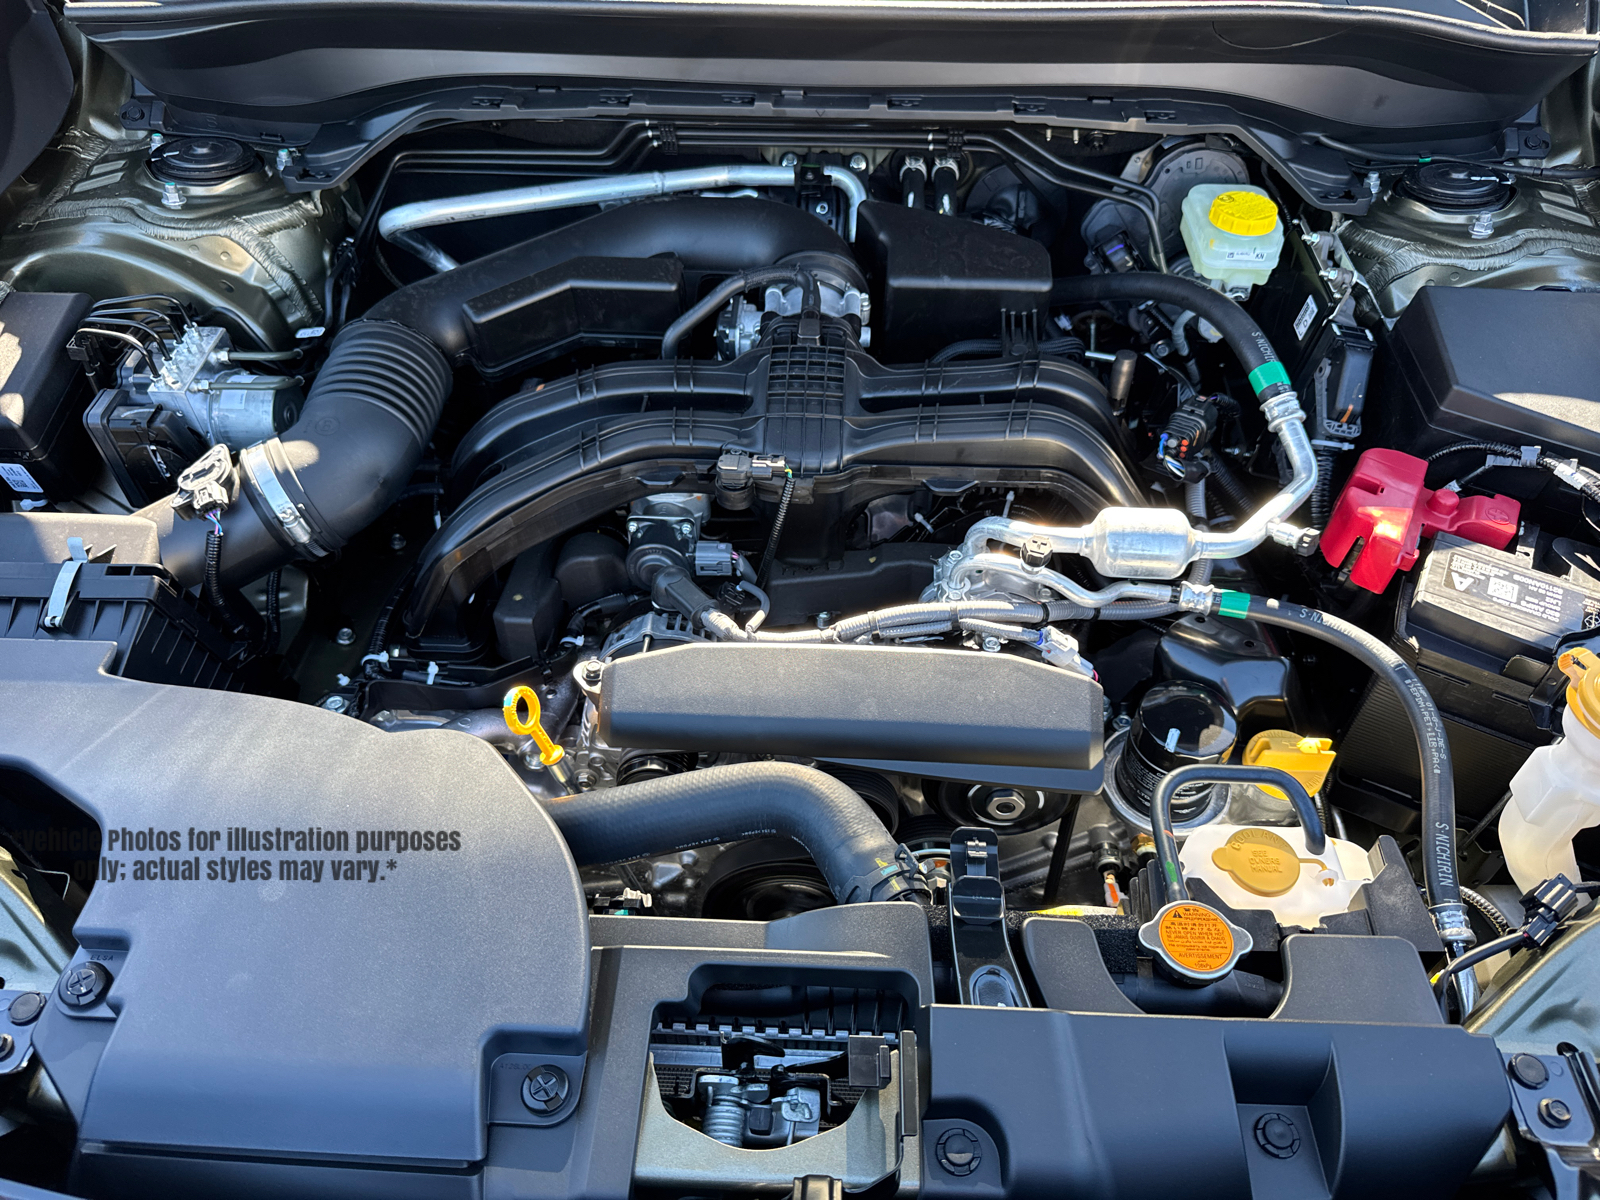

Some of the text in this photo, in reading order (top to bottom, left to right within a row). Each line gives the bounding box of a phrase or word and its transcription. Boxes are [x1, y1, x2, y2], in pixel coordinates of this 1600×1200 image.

[1231, 829, 1289, 850] COOLANT
[1251, 849, 1268, 858] SEE
[1250, 865, 1283, 874] MANUAL
